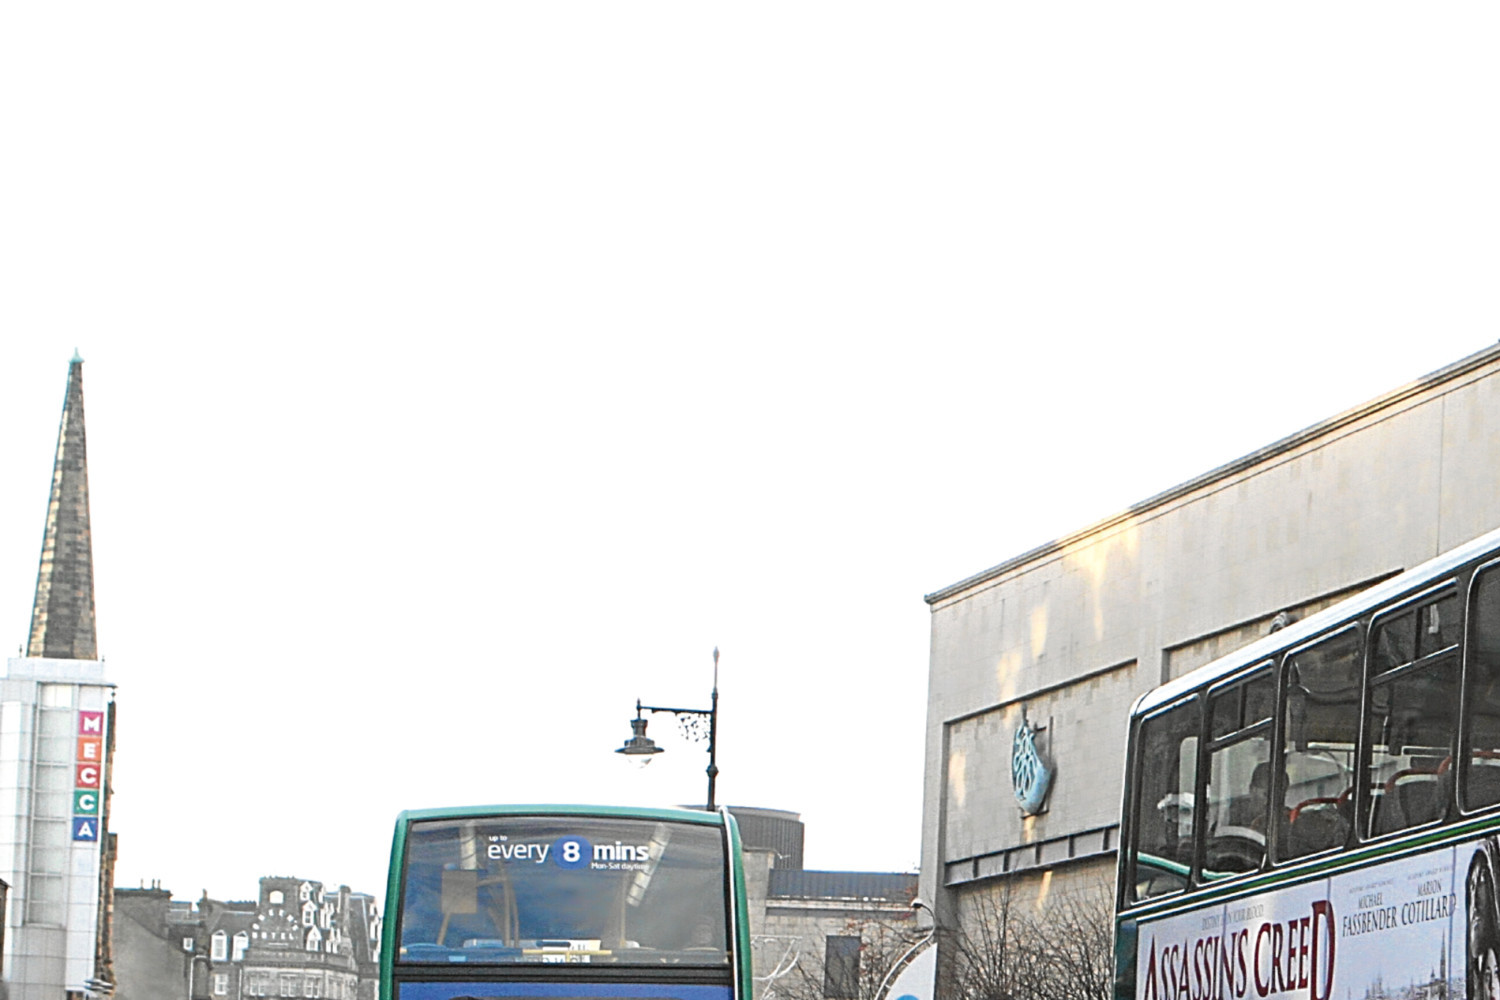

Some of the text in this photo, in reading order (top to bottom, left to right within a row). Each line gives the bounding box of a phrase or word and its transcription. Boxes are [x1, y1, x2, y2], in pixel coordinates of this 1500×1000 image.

[78, 715, 101, 838] MECCA
[487, 840, 650, 864] every 8 mins
[591, 861, 620, 870] Mon-Sat
[1417, 878, 1442, 897] MARION
[1358, 892, 1383, 910] MICHAEL
[1401, 892, 1457, 926] COTILLARD
[1342, 905, 1398, 938] FASSBENDER
